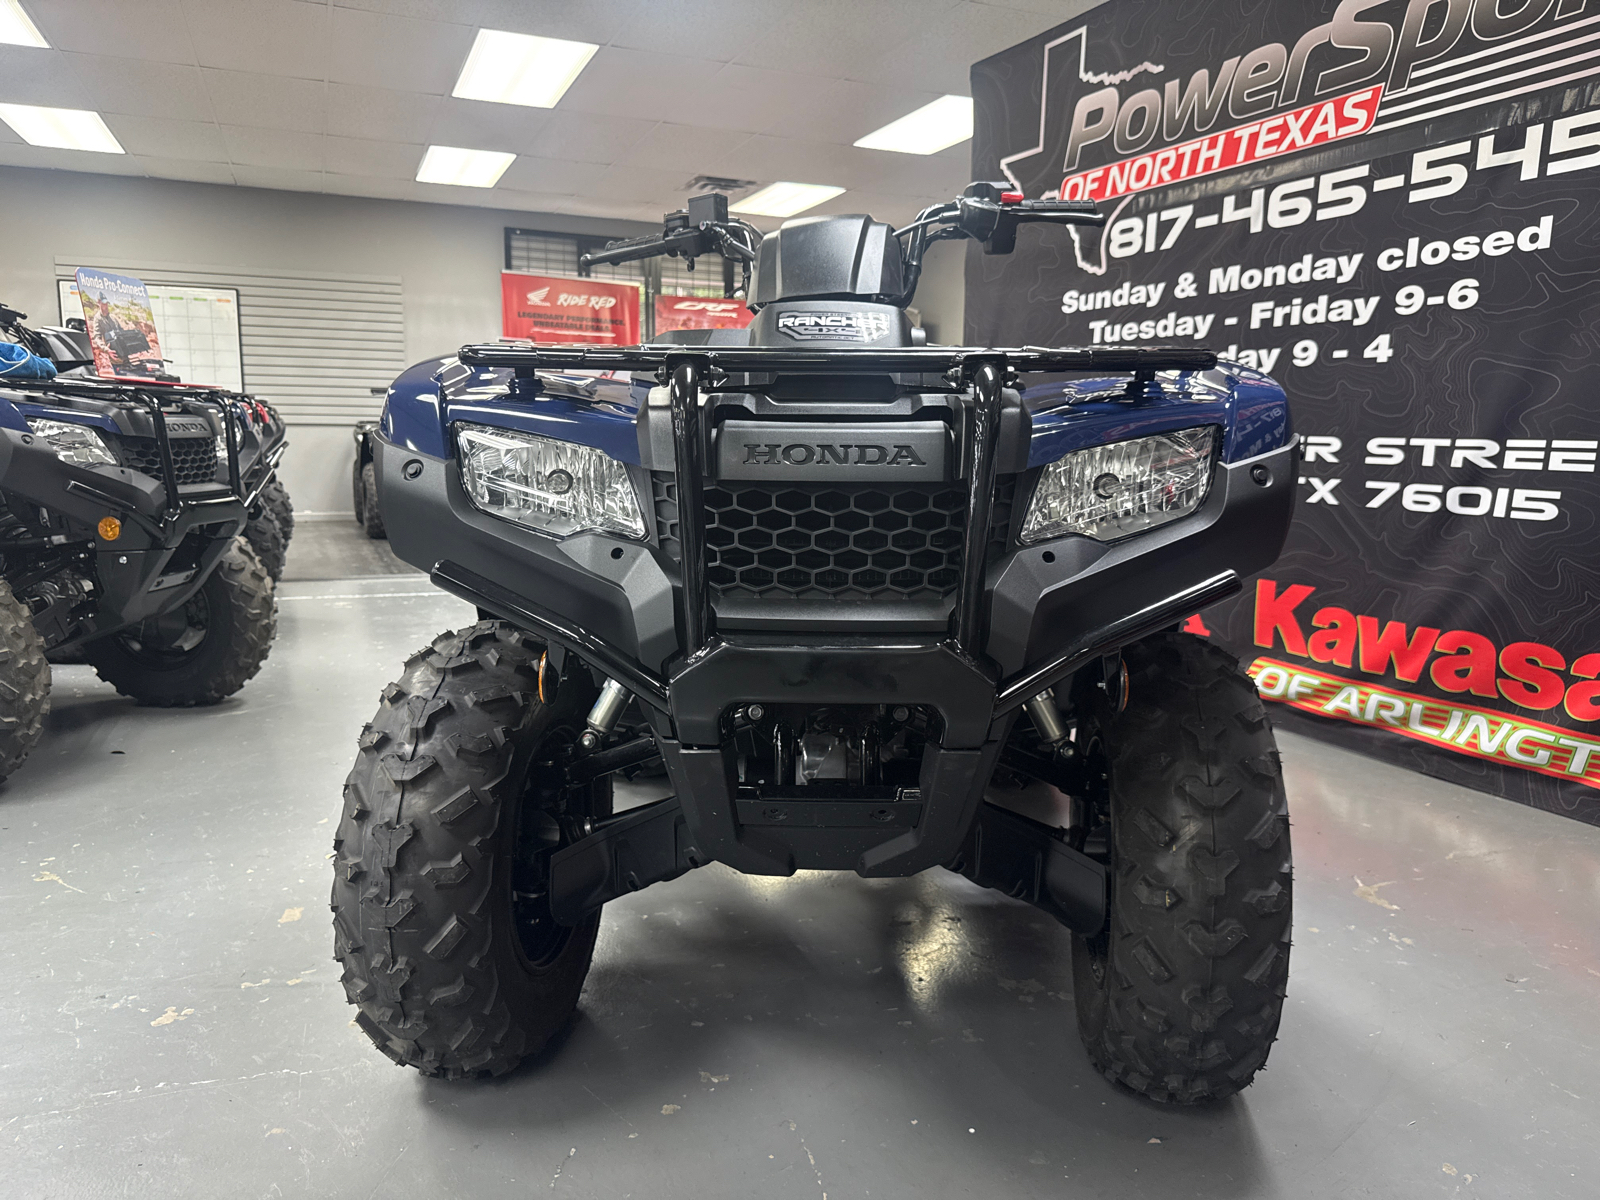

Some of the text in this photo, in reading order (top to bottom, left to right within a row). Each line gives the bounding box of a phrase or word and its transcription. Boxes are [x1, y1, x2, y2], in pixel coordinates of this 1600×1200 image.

[1063, 93, 1374, 201] OF NORTH TEXAS
[1109, 108, 1600, 260] 817-465-545
[1061, 215, 1555, 315] Sunday & Monday closed
[80, 272, 147, 297] Honda Pro-Connect
[557, 293, 617, 310] RIDE RED
[517, 311, 564, 321] LEGENDARY
[673, 301, 740, 312] CRF
[1089, 278, 1480, 345] Tuesday - Friday 9-6
[533, 320, 583, 330] UNBEATABLE
[1292, 339, 1318, 367] 9
[1332, 350, 1349, 359] -
[1363, 334, 1393, 363] 4
[742, 443, 927, 467] HONDA
[1299, 435, 1343, 464] R
[1365, 437, 1599, 473] STREE
[1297, 476, 1562, 521] X 76015
[1256, 666, 1600, 775] OF ARLINGT
